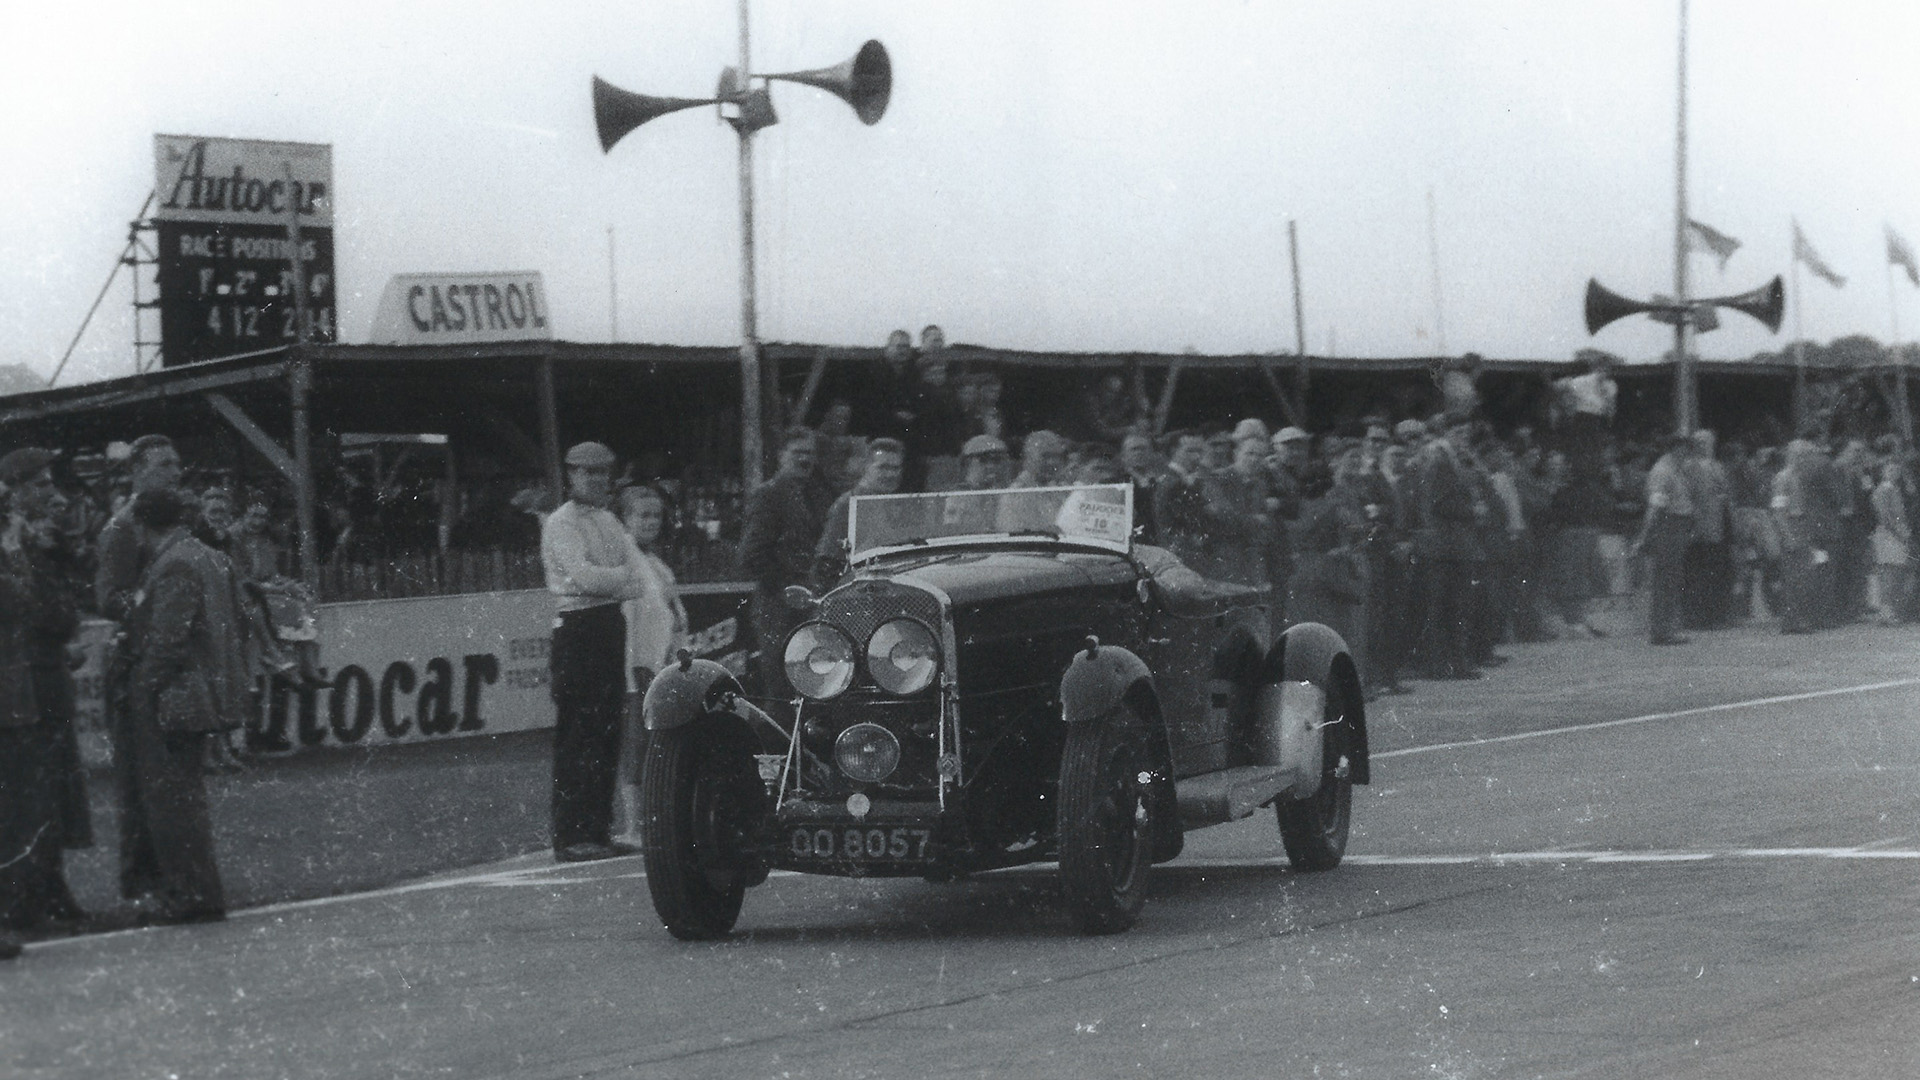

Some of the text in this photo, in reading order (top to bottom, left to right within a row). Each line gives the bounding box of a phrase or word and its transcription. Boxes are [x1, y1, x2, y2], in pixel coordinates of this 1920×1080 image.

[407, 282, 547, 333] CASTROL
[250, 653, 498, 745] utocar
[844, 827, 931, 858] 8057
